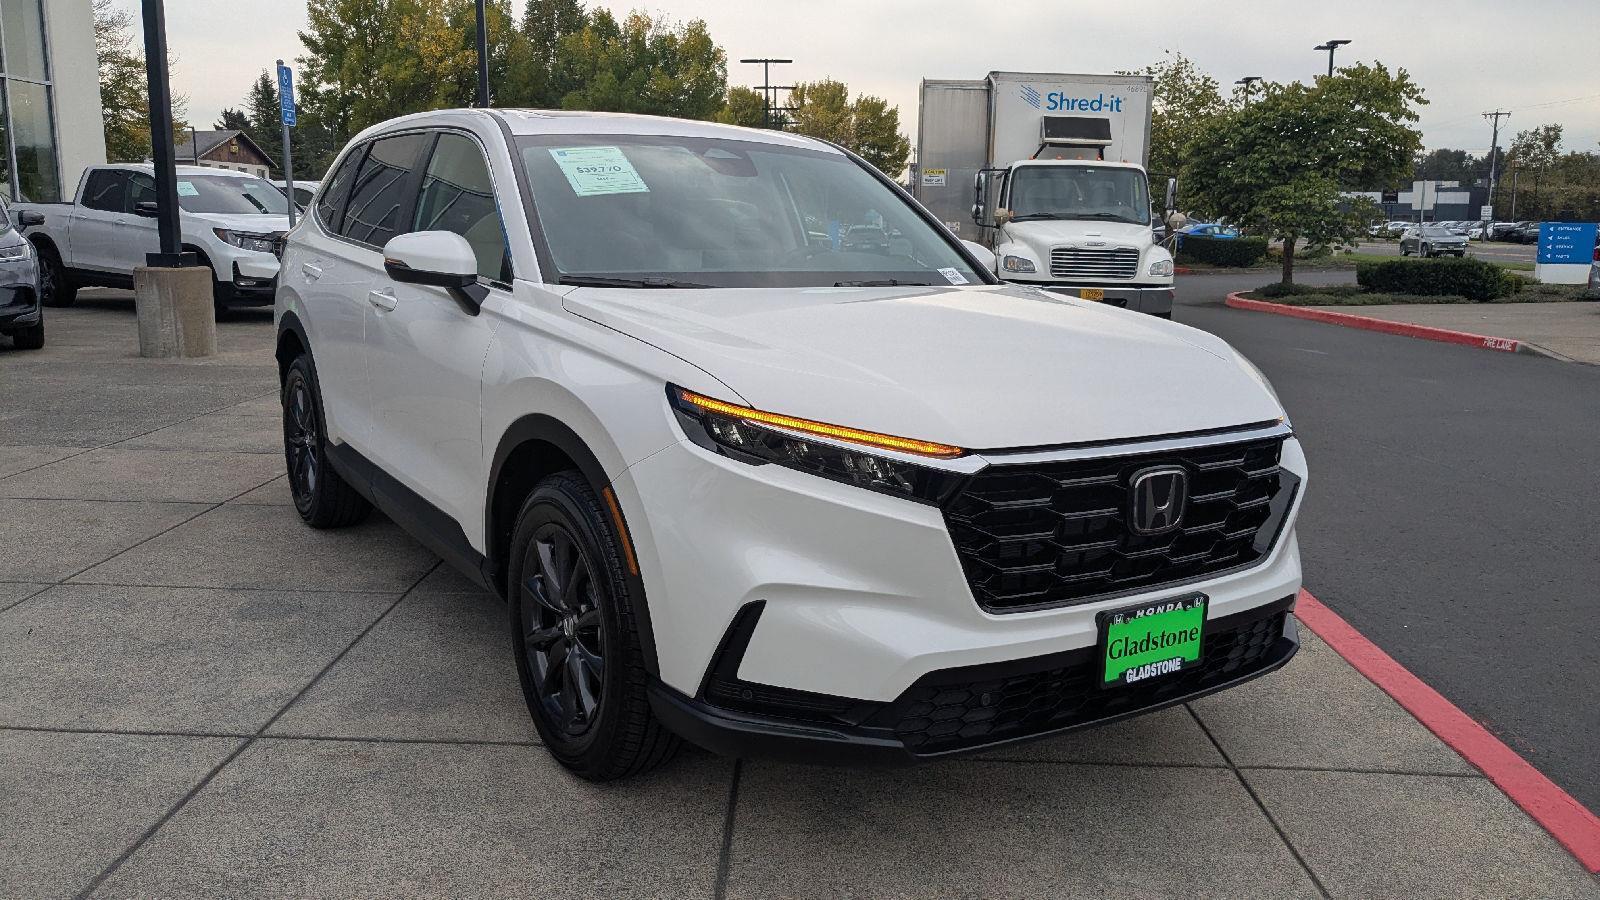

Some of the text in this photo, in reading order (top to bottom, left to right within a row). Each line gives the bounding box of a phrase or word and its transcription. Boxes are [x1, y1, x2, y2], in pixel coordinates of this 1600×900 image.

[1046, 91, 1122, 113] Shred-it
[1135, 602, 1184, 619] HONDA
[1108, 626, 1199, 660] Gladstone
[1125, 658, 1182, 683] GLADSTONE
